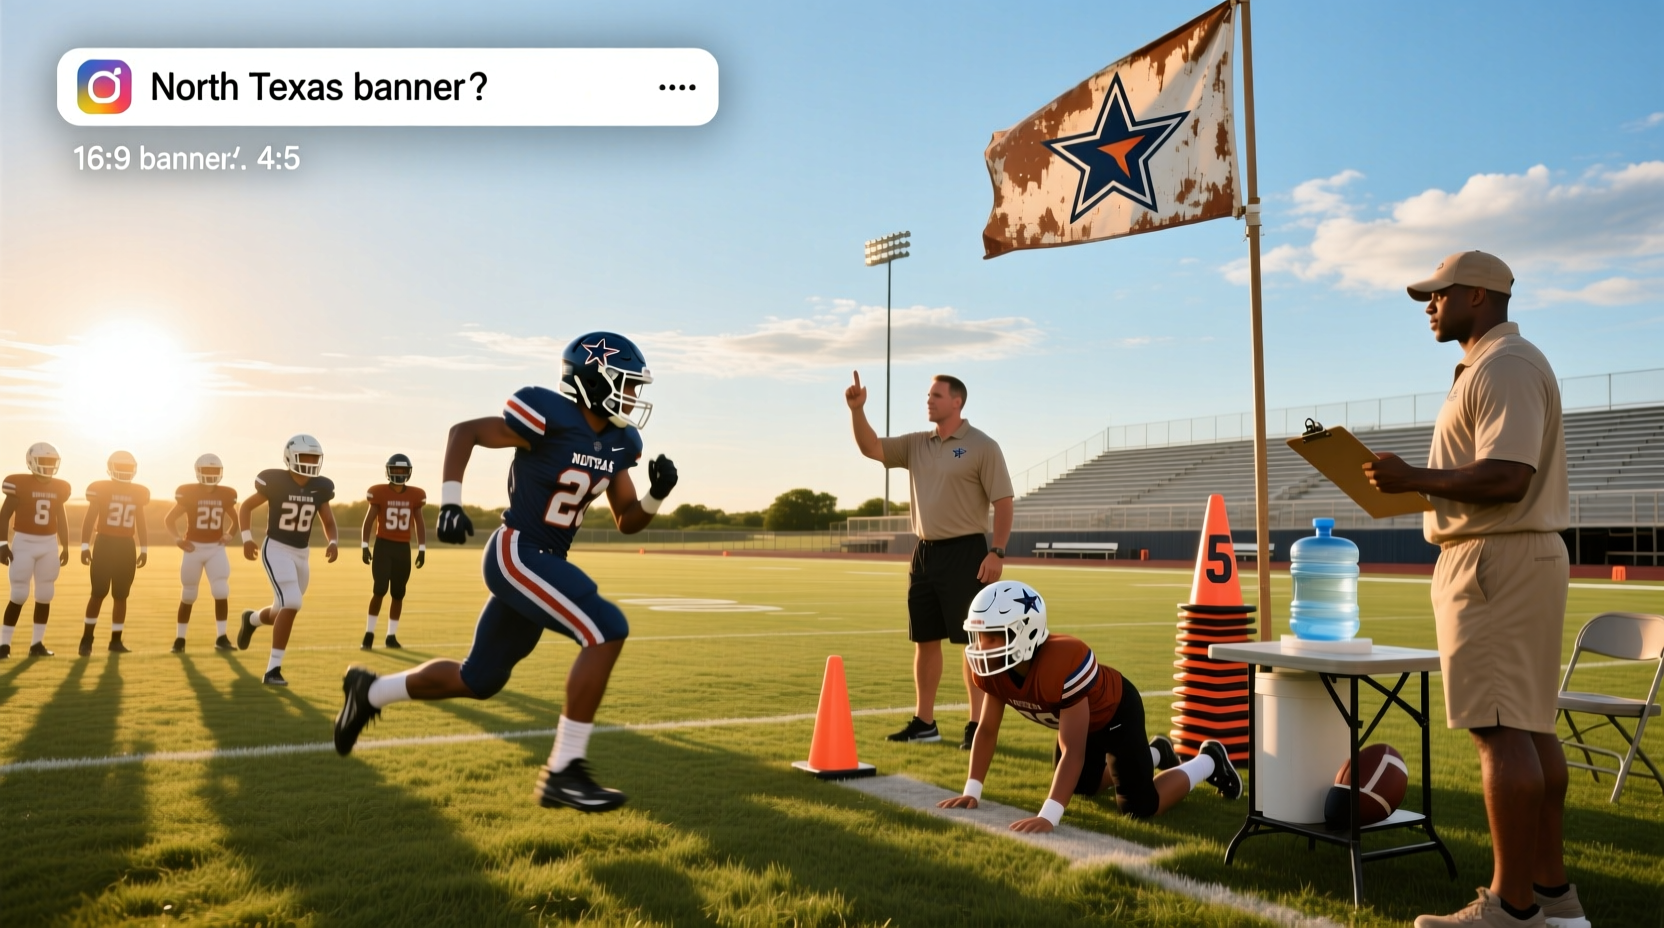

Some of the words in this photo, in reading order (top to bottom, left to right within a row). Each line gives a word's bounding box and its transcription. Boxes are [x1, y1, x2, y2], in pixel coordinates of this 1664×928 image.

[278, 501, 316, 532] 28
[385, 507, 411, 531] 53
[1205, 534, 1233, 584] 5
